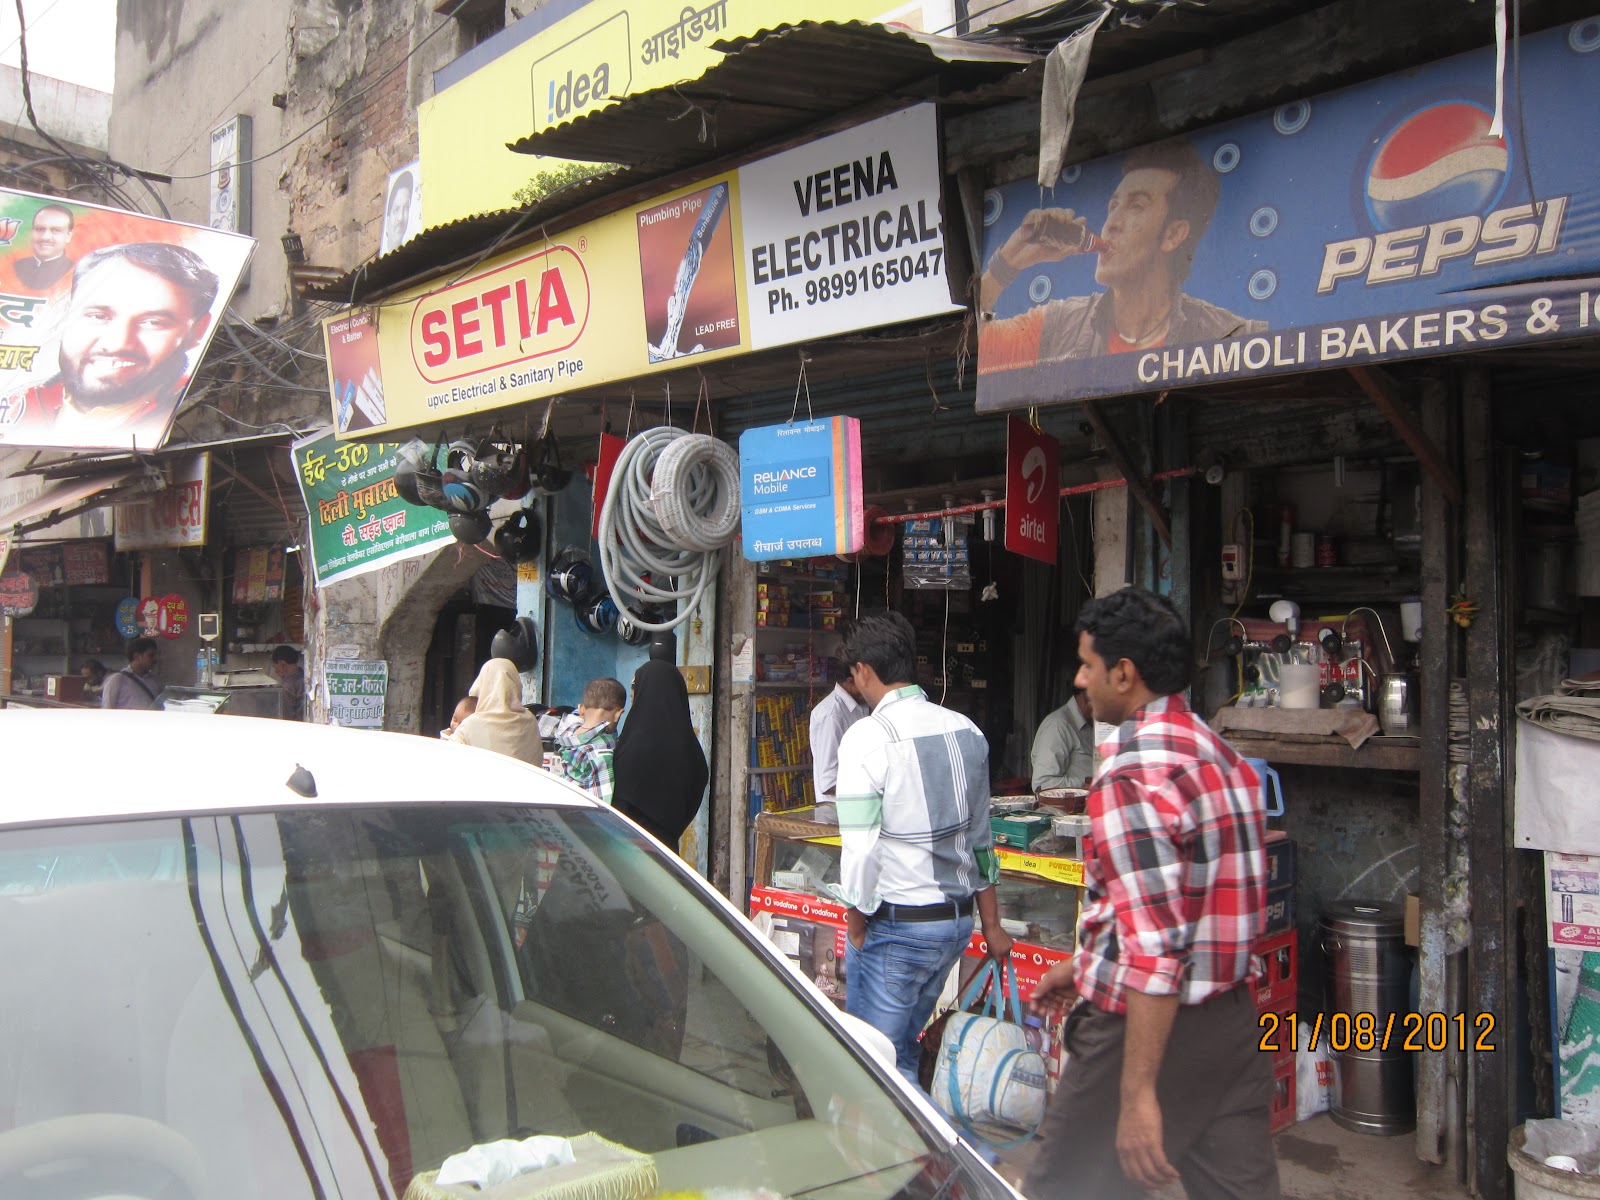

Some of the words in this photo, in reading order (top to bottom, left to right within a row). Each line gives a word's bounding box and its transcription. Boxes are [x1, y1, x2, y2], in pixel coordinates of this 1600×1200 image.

[641, 0, 728, 65] आइडिया
[794, 151, 898, 217] VEENA
[640, 205, 680, 228] Plumbing
[682, 197, 702, 216] Pipe
[697, 199, 719, 239] Schedule
[1315, 196, 1568, 296] PEPSI
[768, 287, 799, 314] Ph.
[806, 248, 943, 305] 9899165047
[421, 266, 575, 368] SETIA
[695, 322, 715, 336] LEAD
[716, 318, 736, 332] FREE
[1137, 332, 1306, 384] CHAMOLI
[1320, 303, 1509, 362] BAKERS
[1529, 297, 1560, 335] &
[1579, 291, 1600, 328] I
[427, 393, 450, 408] upvc
[452, 380, 497, 403] Electrical
[499, 377, 507, 391] &
[510, 366, 554, 389] Sanitary
[558, 358, 584, 378] Pipe
[754, 482, 788, 495] Mobile
[755, 507, 768, 515] GSM
[774, 505, 791, 513] CDMA
[792, 503, 817, 511] Services
[1020, 514, 1046, 544] airtel
[773, 900, 798, 911] vodafone
[811, 908, 838, 919] vodafone
[1266, 900, 1285, 922] PSI
[1009, 951, 1027, 960] fone
